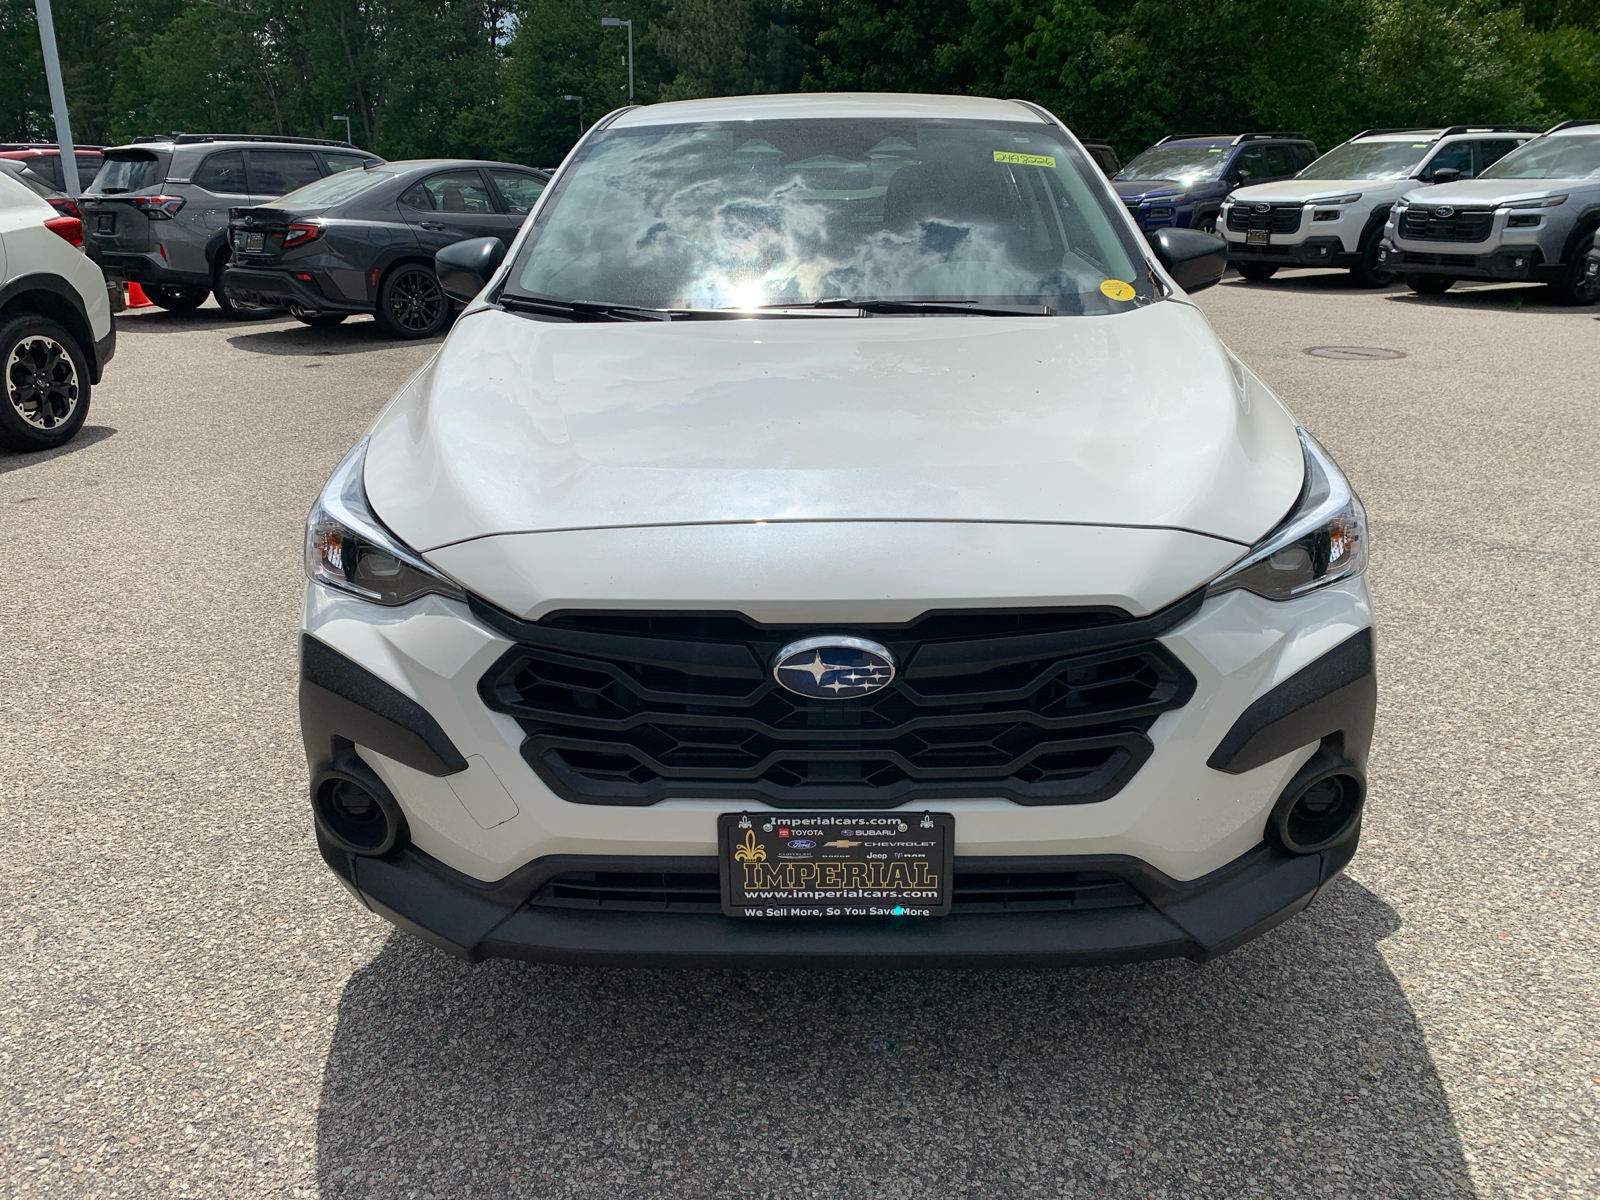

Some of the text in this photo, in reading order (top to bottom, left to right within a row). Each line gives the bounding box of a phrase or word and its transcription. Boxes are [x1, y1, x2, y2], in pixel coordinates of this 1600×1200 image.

[770, 816, 902, 826] Imperialcars.com
[791, 840, 812, 849] Ford
[866, 852, 888, 860] Jeep
[743, 862, 938, 889] IMPERIAL
[744, 890, 938, 899] www.imperialcars.com
[745, 908, 763, 917] We
[766, 908, 787, 917] Sell
[790, 908, 823, 917] More,
[826, 907, 841, 916] So
[845, 907, 867, 916] You
[901, 907, 930, 916] More
